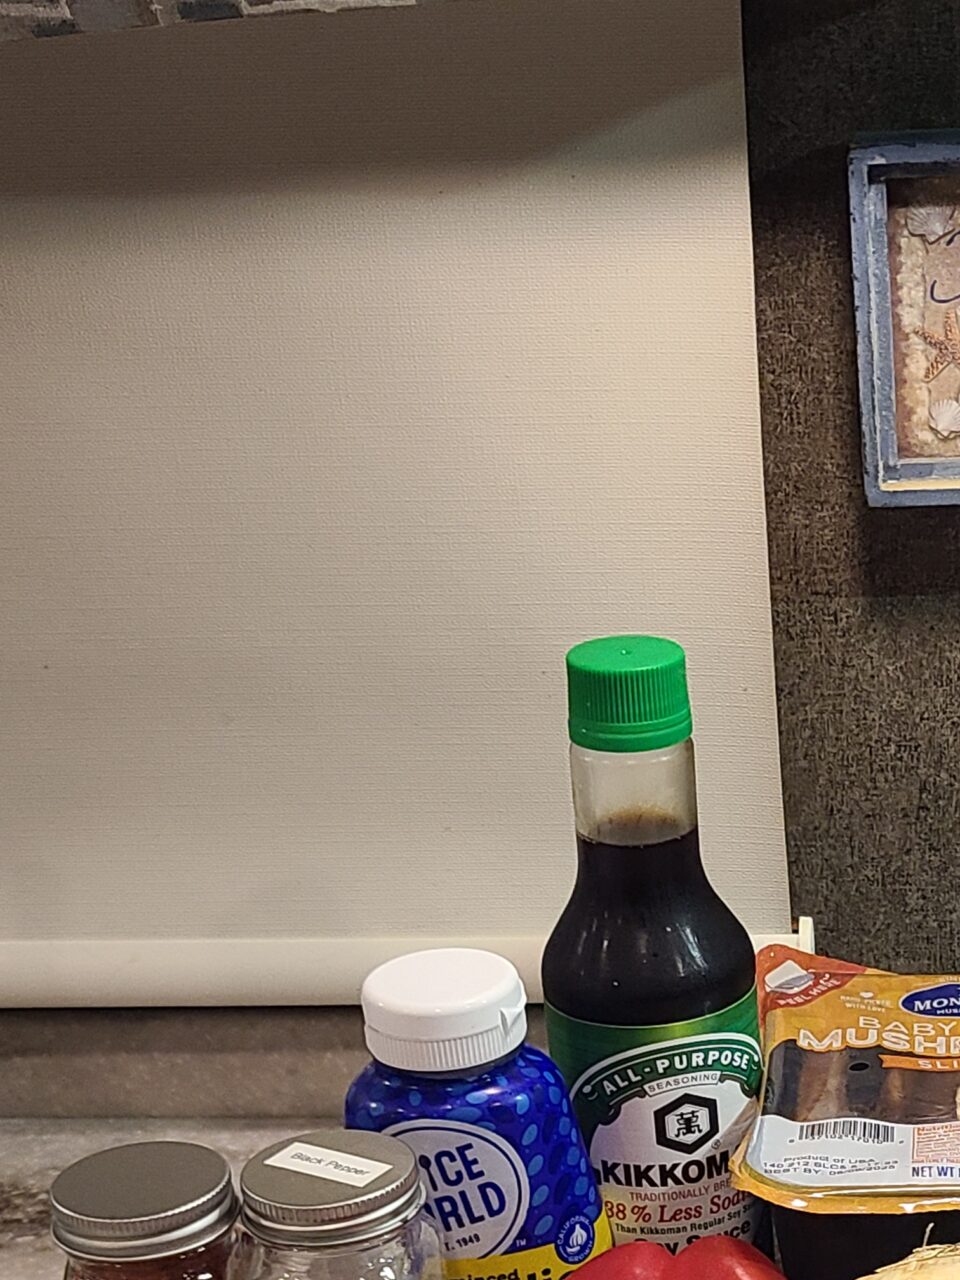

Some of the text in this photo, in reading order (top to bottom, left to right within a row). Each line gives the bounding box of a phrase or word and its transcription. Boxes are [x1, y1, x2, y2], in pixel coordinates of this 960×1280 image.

[858, 1015, 958, 1036] BABY
[648, 1073, 718, 1093] SEASONING
[290, 1151, 371, 1176] Black Pepper
[600, 1150, 730, 1188] KIKKOM
[912, 1166, 934, 1177] NET
[937, 1165, 956, 1177] WT
[630, 1179, 732, 1202] TRADITIONALLY BRE
[424, 1181, 507, 1233] RLD
[658, 1204, 703, 1223] Less
[615, 1223, 637, 1234] Than
[640, 1226, 688, 1235] Kikkoman
[690, 1217, 725, 1231] Regular
[727, 1210, 742, 1221] Soy
[456, 1233, 481, 1248] 1949
